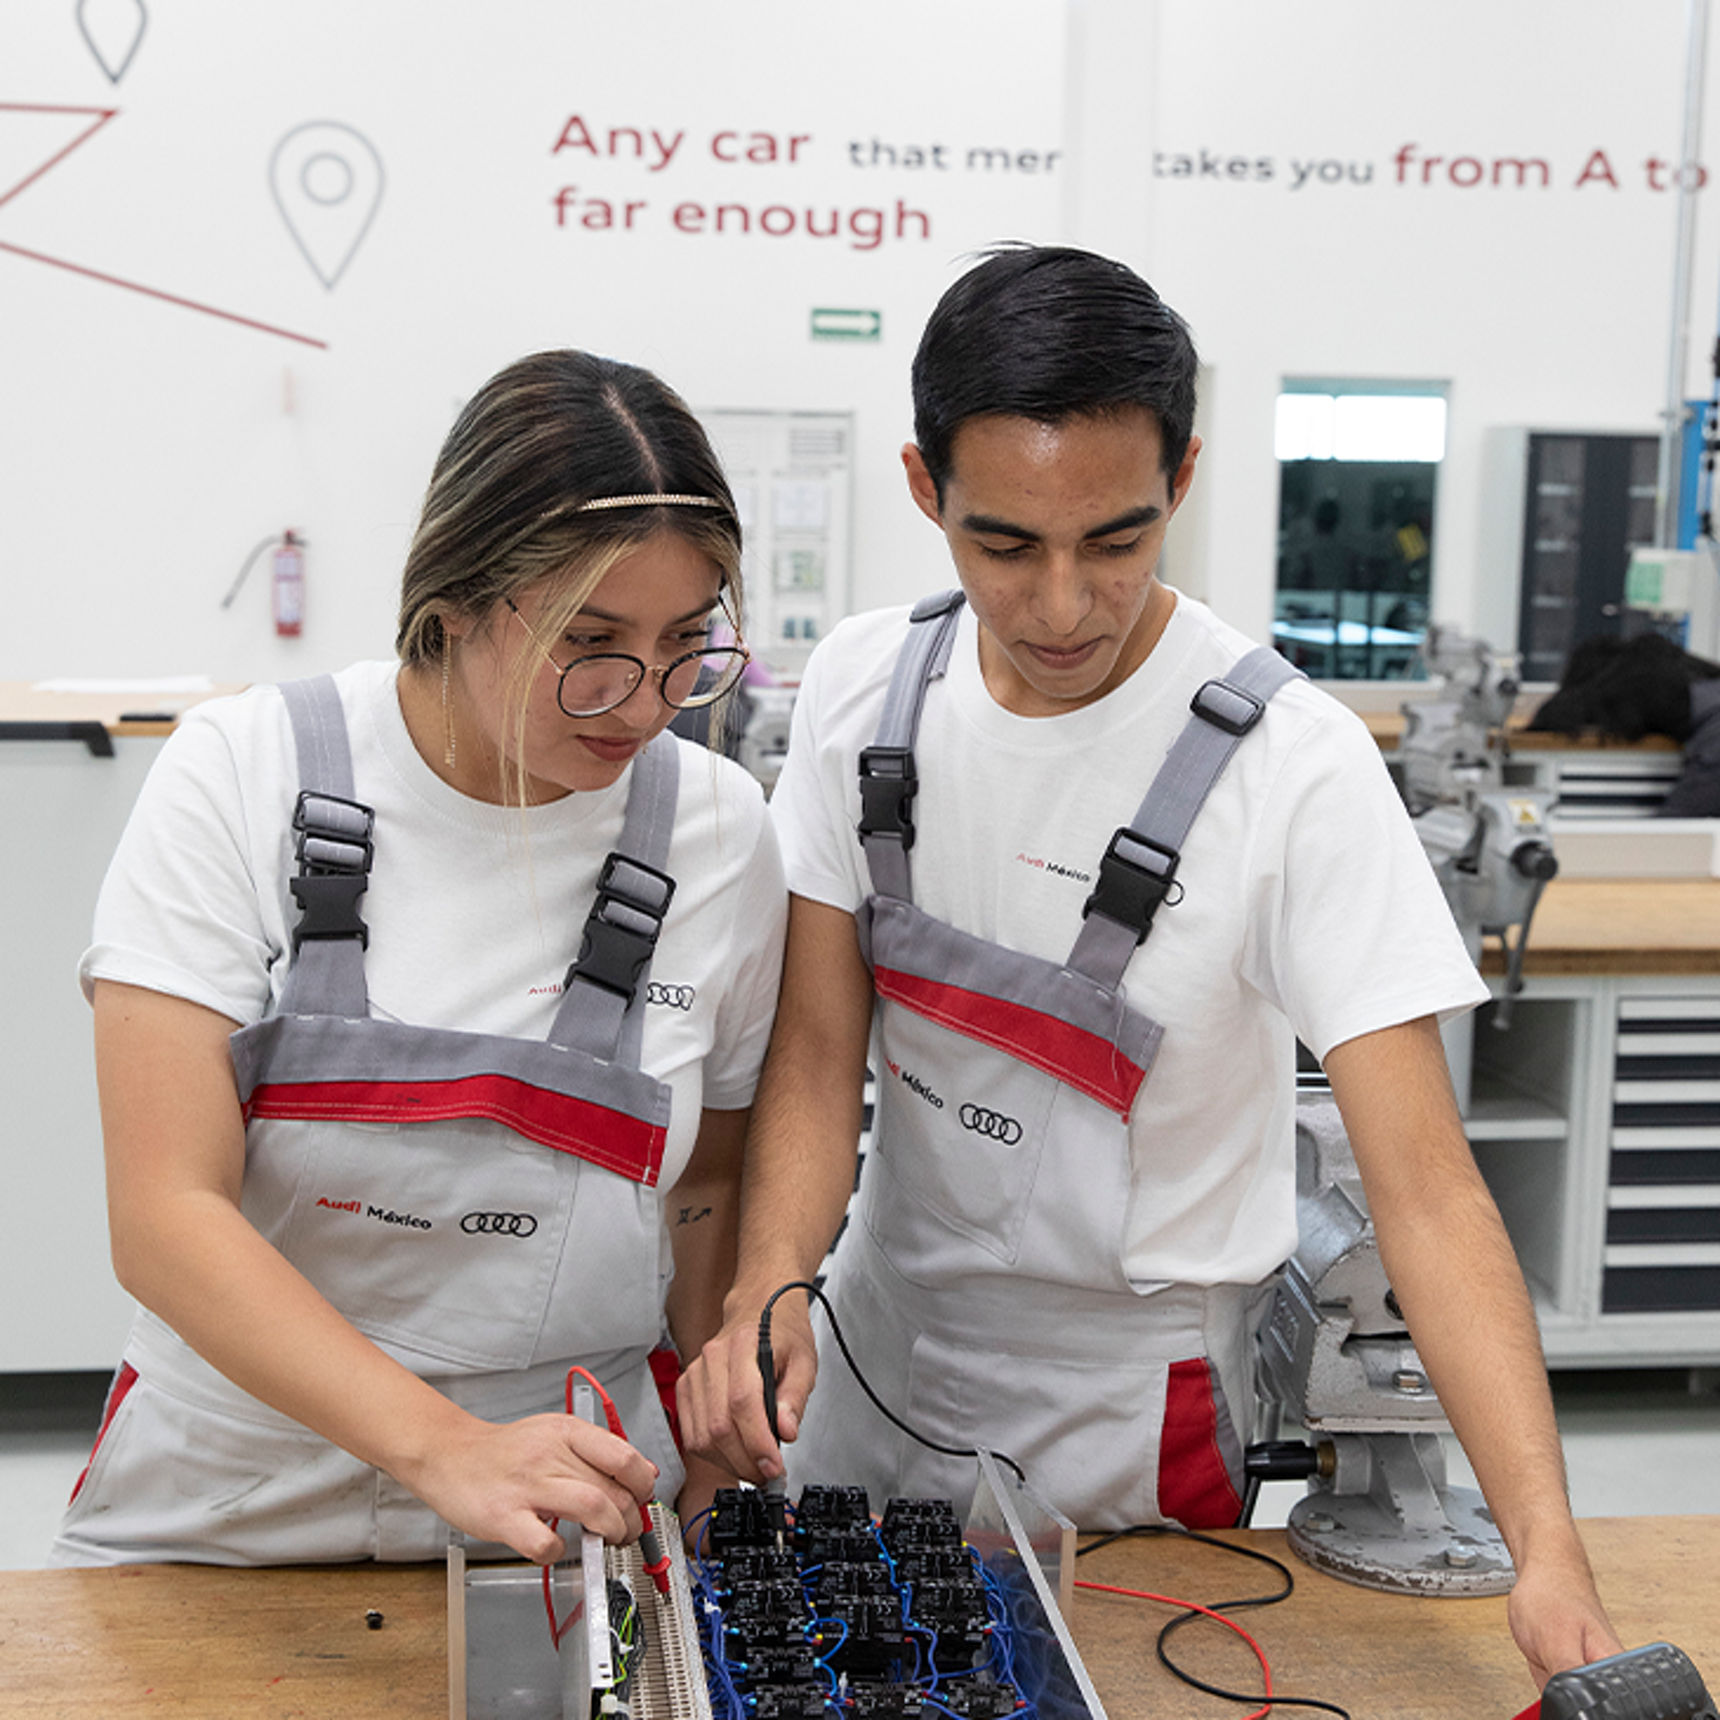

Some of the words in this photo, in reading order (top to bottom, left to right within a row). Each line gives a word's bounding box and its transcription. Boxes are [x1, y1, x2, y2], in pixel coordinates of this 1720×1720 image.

[551, 114, 686, 172] Any
[711, 129, 811, 163] car
[848, 137, 949, 171] that
[966, 148, 1062, 174] mer
[1154, 147, 1276, 182] takes
[1290, 161, 1374, 191] you
[1393, 142, 1551, 189] from
[1575, 150, 1620, 190] A
[1644, 157, 1708, 193] to
[552, 187, 648, 231] far
[672, 200, 931, 251] enough
[316, 1197, 361, 1214] Audi
[367, 1206, 431, 1230] México
